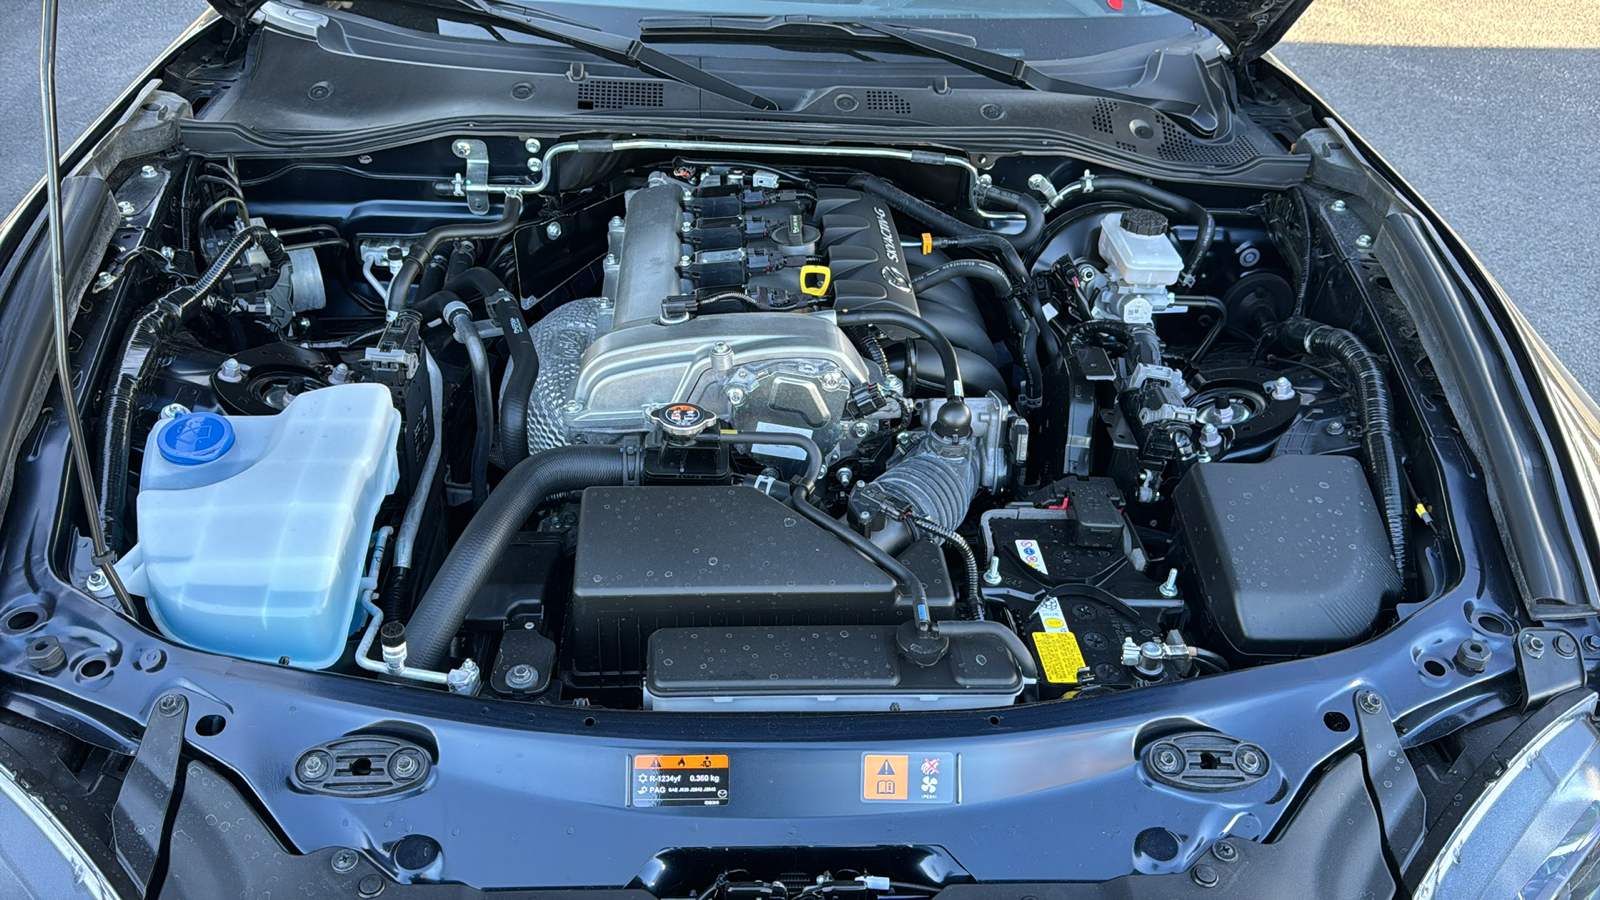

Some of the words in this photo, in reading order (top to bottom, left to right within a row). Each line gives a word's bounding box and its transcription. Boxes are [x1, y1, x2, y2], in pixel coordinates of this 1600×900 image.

[873, 206, 899, 263] SKYACTIV-G
[649, 775, 681, 783] R-1234yf
[710, 774, 720, 783] kg
